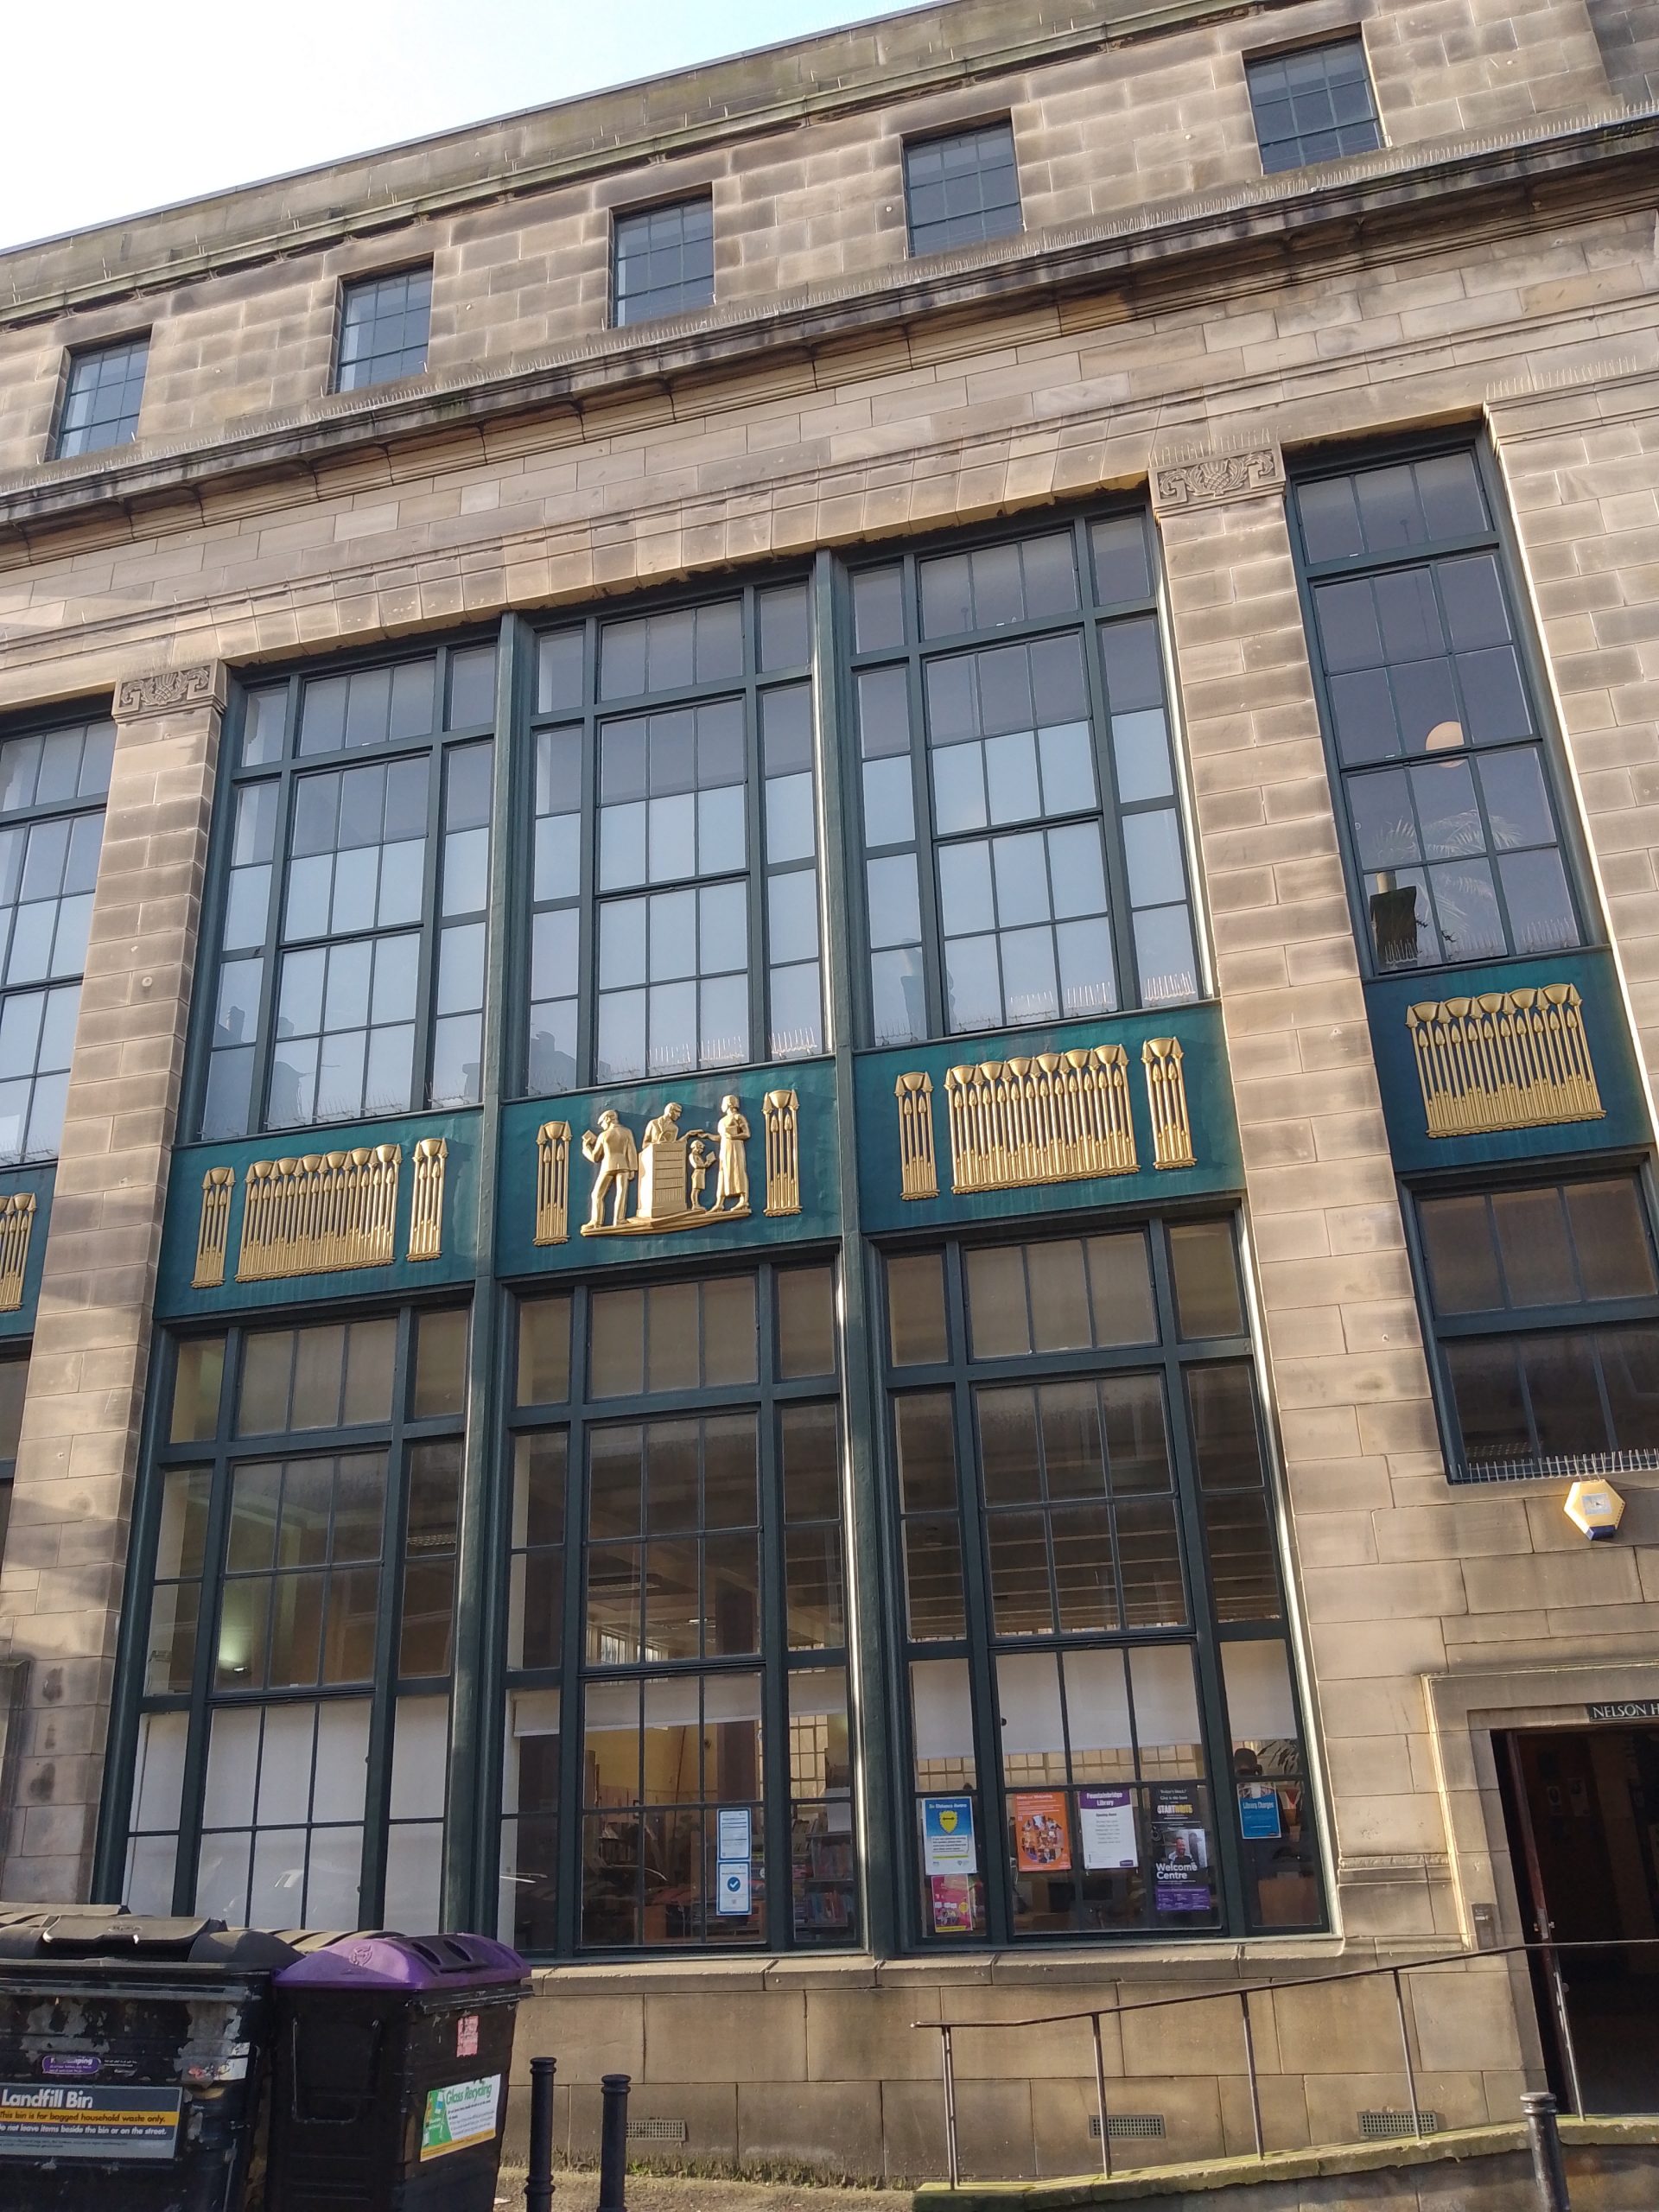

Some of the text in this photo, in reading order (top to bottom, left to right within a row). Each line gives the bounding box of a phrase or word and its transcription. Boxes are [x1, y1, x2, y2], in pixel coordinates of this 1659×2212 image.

[1592, 1704, 1647, 1718] NELSON
[1258, 1801, 1274, 1810] Charges
[1155, 1862, 1198, 1872] Welcome
[1156, 1871, 1188, 1880] Centre
[1, 2088, 93, 2109] Landfill Bin
[447, 2084, 492, 2104] Glass Recycling
[0, 2110, 166, 2124] This bin is for bagged household waste only.
[20, 2123, 39, 2133] leave
[41, 2124, 59, 2133] items
[60, 2125, 83, 2133] beside
[85, 2125, 96, 2134] the
[98, 2126, 110, 2134] bin
[131, 2126, 143, 2135] the
[144, 2126, 167, 2136] street.
